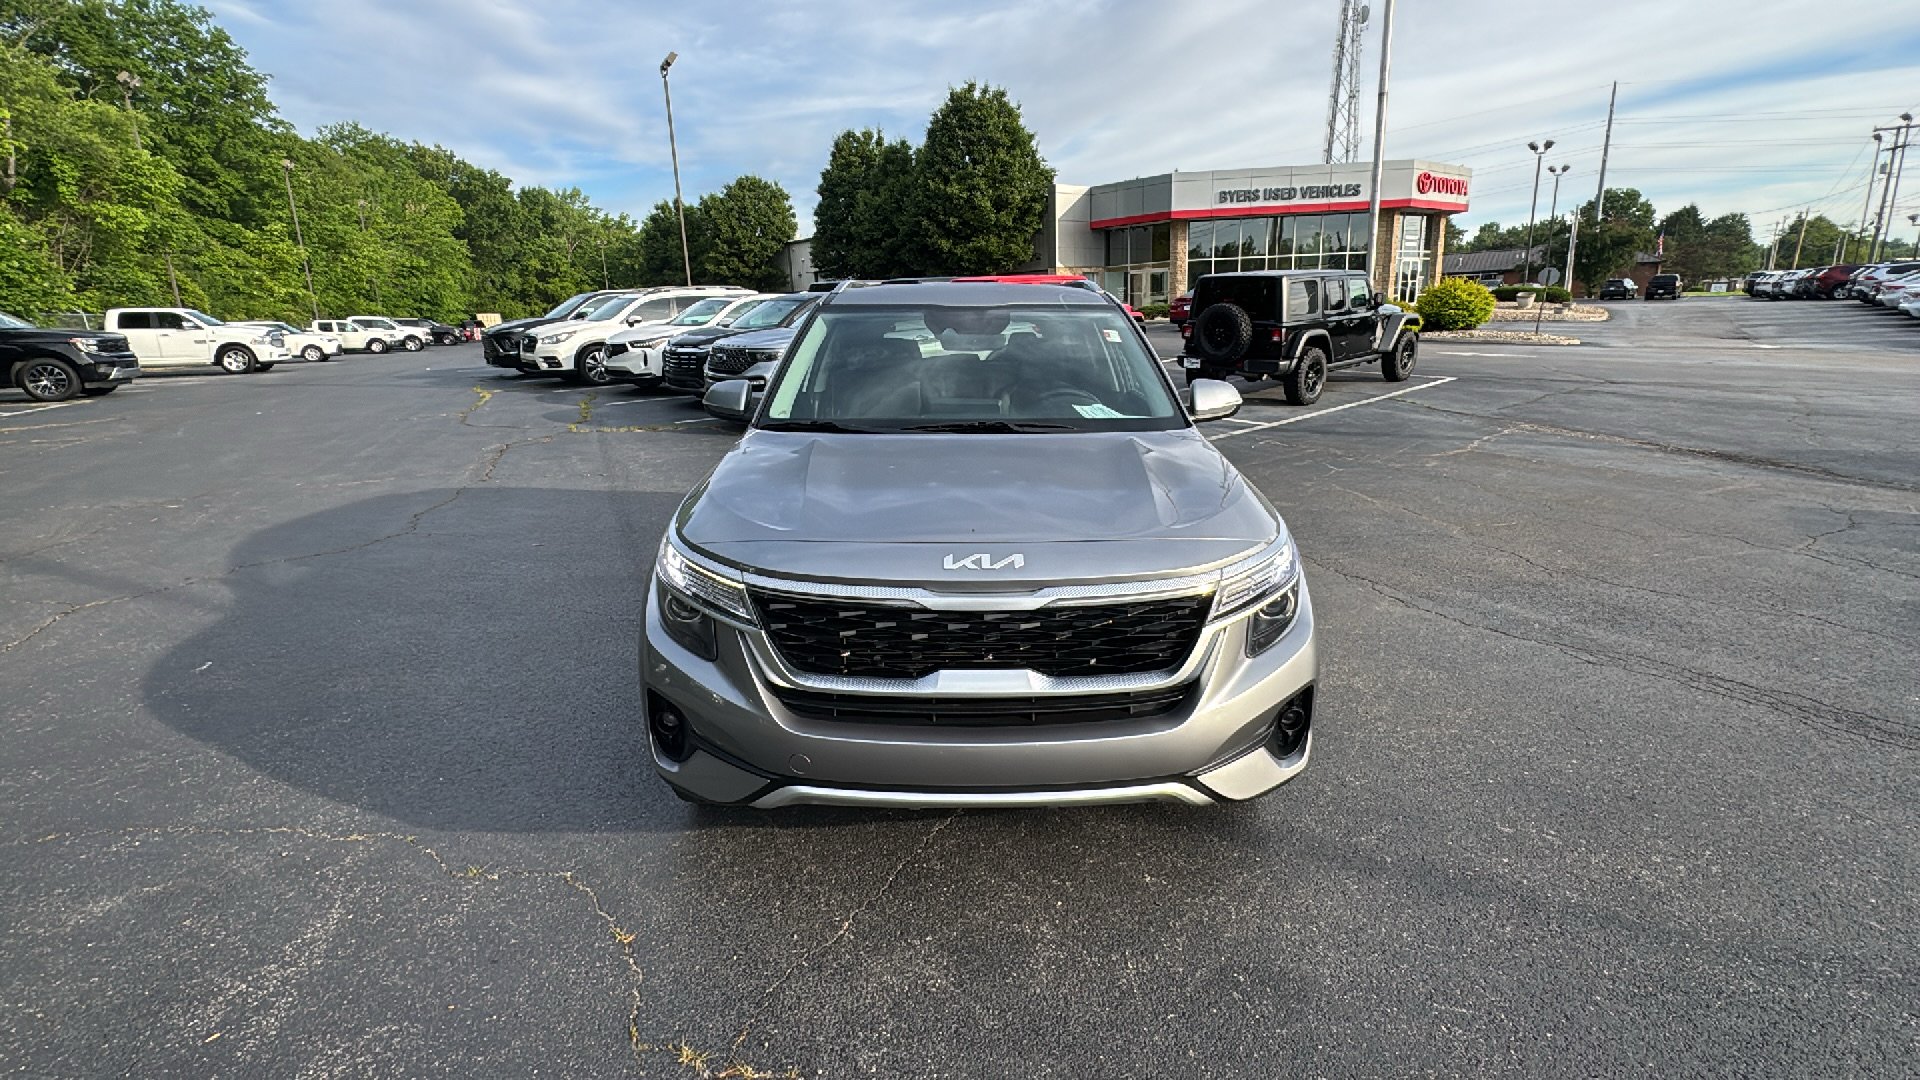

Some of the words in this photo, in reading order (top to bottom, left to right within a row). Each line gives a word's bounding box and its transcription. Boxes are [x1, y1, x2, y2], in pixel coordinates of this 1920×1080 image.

[1218, 188, 1261, 204] BYERS
[1263, 186, 1298, 201] USED
[1300, 183, 1362, 199] VEHICLES
[1432, 176, 1468, 196] TOYOTA
